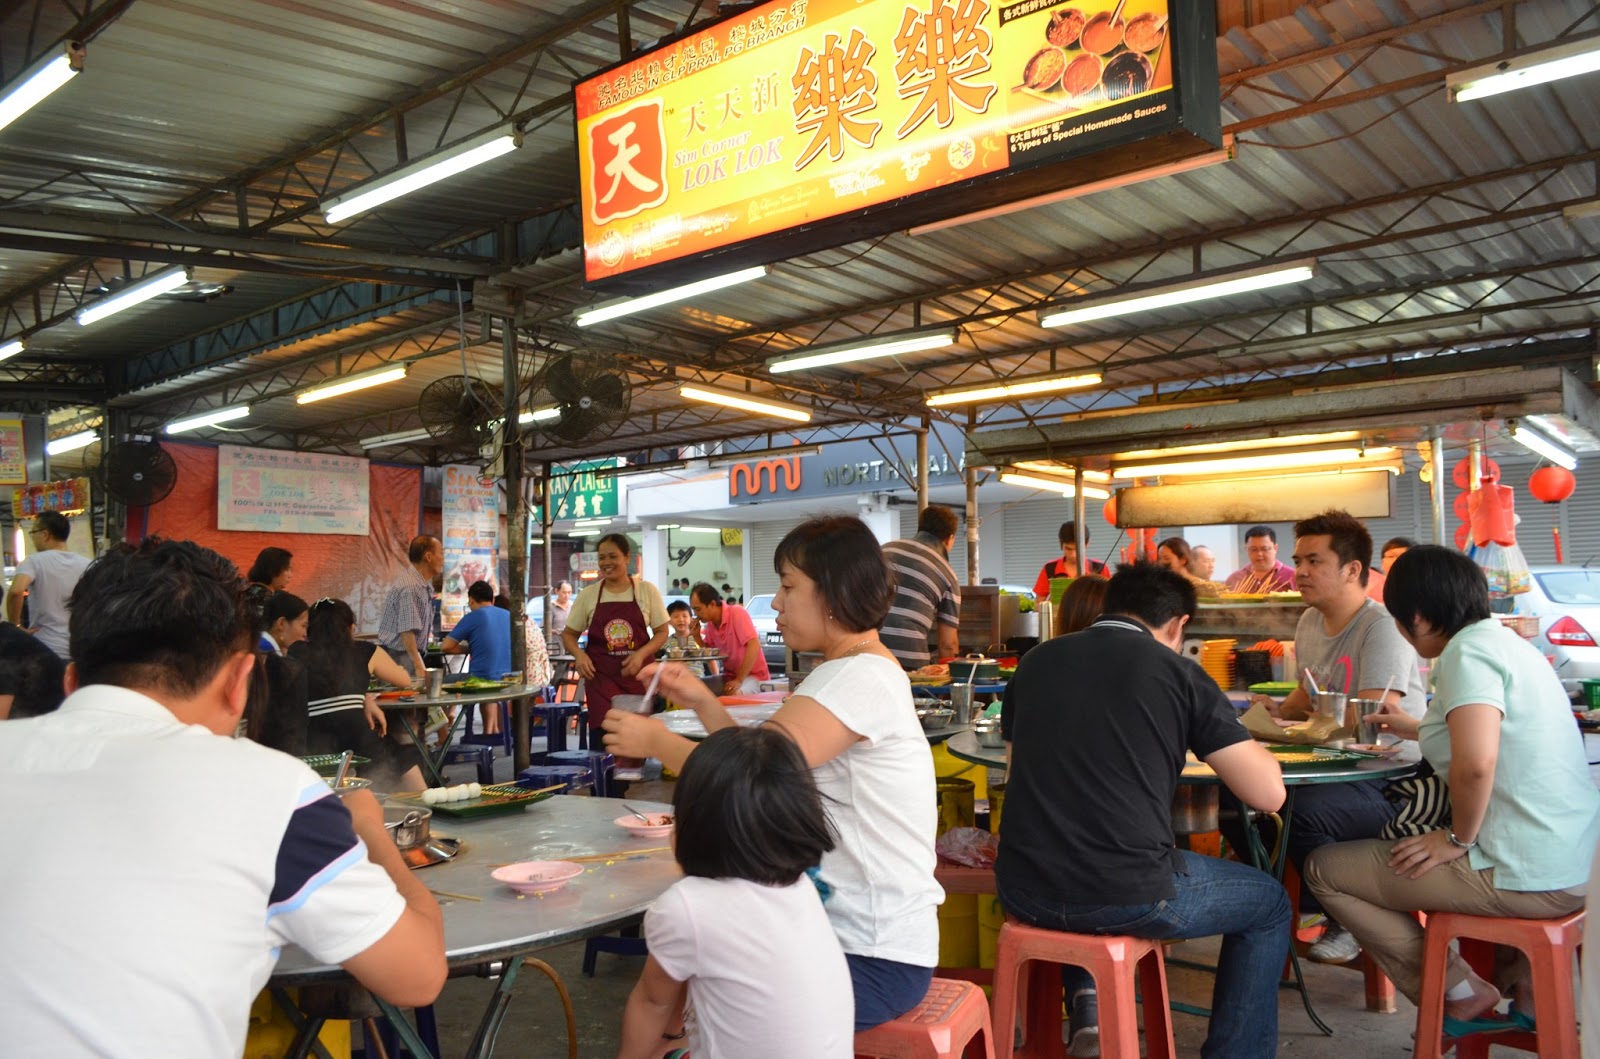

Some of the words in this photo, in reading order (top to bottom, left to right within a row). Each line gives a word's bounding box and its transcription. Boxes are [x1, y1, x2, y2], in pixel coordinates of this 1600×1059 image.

[730, 1, 807, 42] 槟城分行
[598, 82, 645, 109] FAMOUS
[647, 76, 660, 91] IN
[662, 64, 686, 82] CLP
[723, 42, 744, 58] PG
[747, 16, 806, 49] BRANCH
[683, 72, 781, 141] 天天新
[1010, 143, 1017, 153] 6
[1018, 138, 1041, 153] Types
[1042, 134, 1052, 145] of
[1052, 125, 1083, 142] Special
[1084, 112, 1133, 131] Homemade
[1133, 103, 1168, 119] Sauces
[600, 121, 660, 205] 天
[682, 156, 728, 191] LOK
[735, 137, 783, 174] LOK
[702, 132, 751, 157] Corner
[572, 465, 612, 493] PLANET
[823, 460, 899, 487] NORTH
